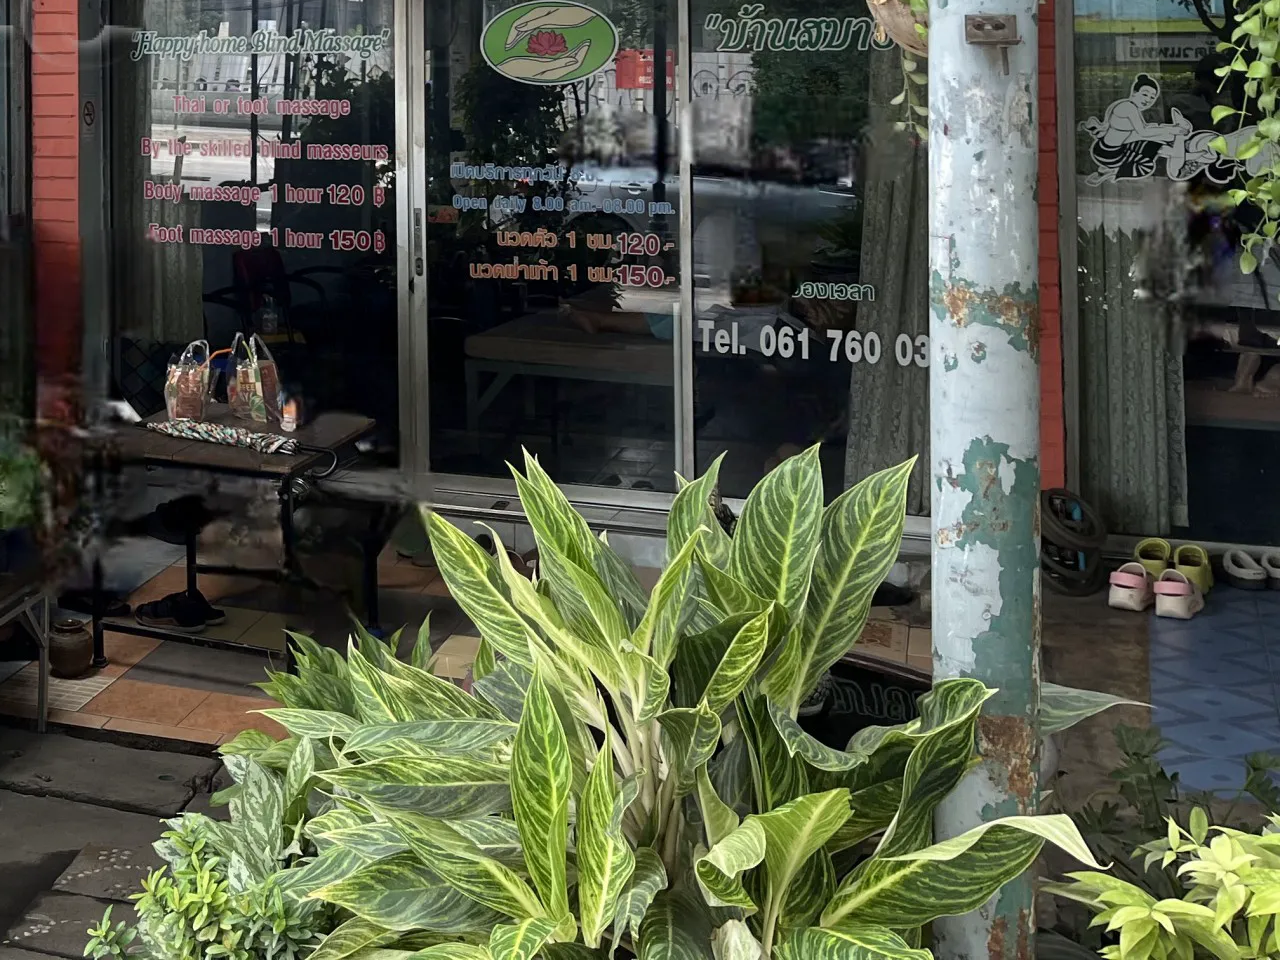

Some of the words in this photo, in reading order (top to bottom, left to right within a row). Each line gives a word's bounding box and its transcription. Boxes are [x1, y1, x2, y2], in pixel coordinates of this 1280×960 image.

[196, 30, 247, 54] home
[252, 28, 301, 55] Blind
[172, 95, 207, 115] Thai
[213, 99, 230, 115] or
[237, 96, 269, 116] foot
[276, 99, 351, 120] massage
[140, 137, 162, 159] By
[169, 138, 192, 156] the
[199, 138, 253, 158] skilled
[258, 140, 301, 159] blind
[307, 143, 389, 161] masseurs
[143, 180, 182, 204] Body
[189, 185, 261, 206] massage
[270, 185, 279, 203] 1
[285, 184, 323, 204] hour
[326, 184, 365, 205] 120
[452, 194, 488, 212] Open
[494, 195, 527, 213] daily
[532, 196, 564, 211] 8.00
[648, 200, 677, 217] pm.
[150, 223, 184, 244] Foot
[190, 228, 262, 250] massage
[270, 228, 279, 247] 1
[285, 228, 323, 248] hour
[329, 230, 371, 251] 150
[496, 227, 559, 248] นวดตัว
[566, 230, 576, 249] 1
[567, 264, 578, 282] 1
[697, 319, 747, 356] Tel.
[759, 324, 810, 360] 061
[826, 328, 882, 365] 760
